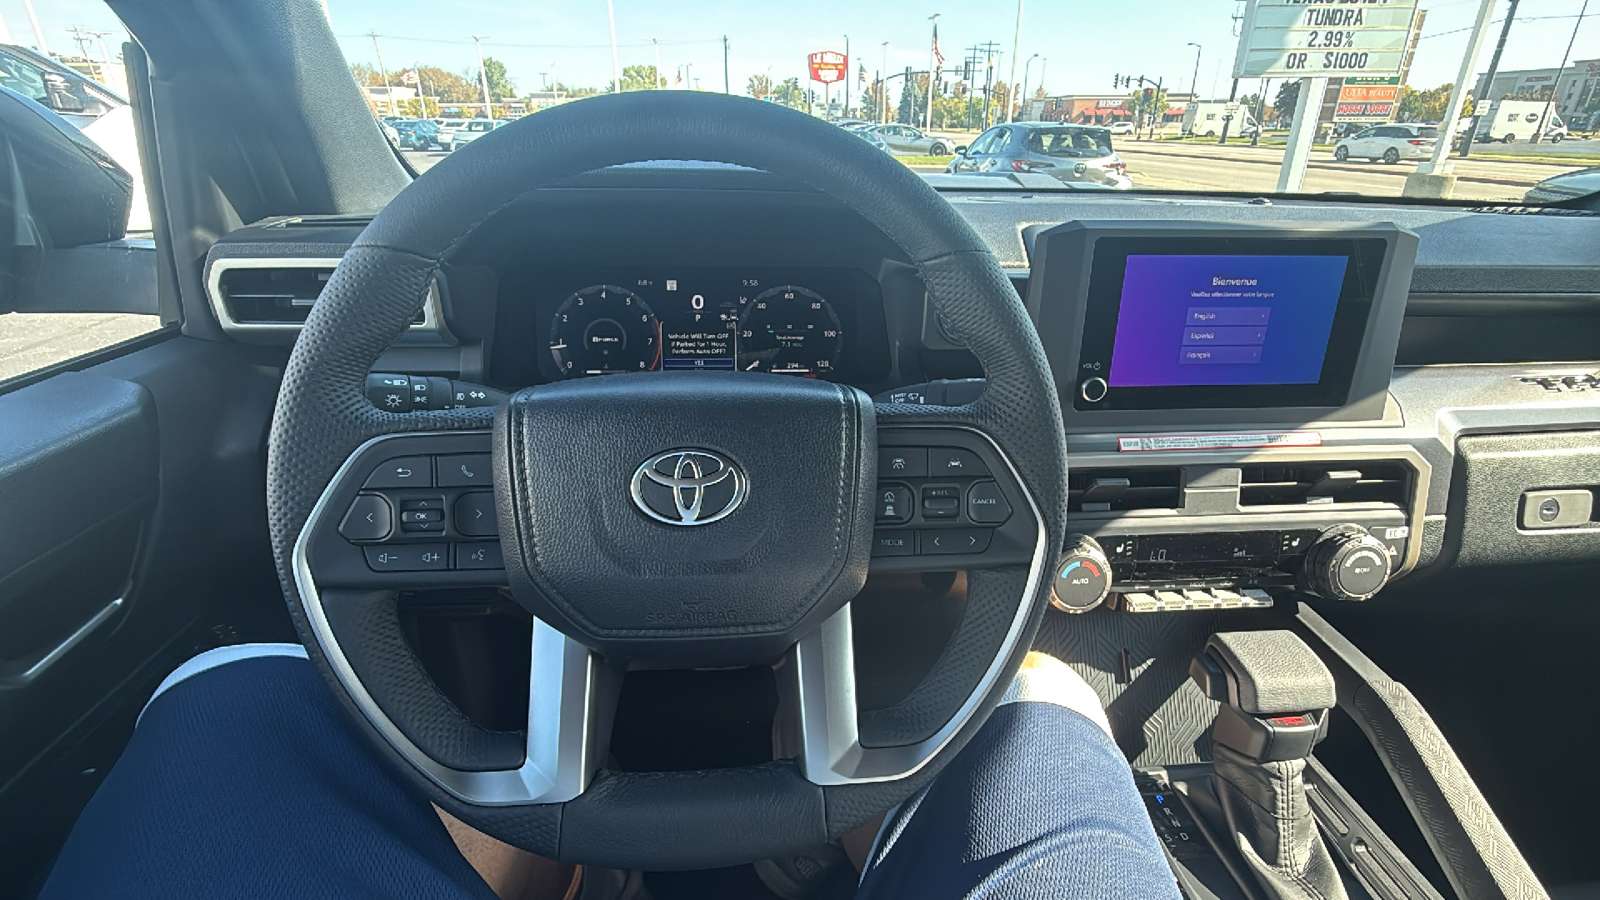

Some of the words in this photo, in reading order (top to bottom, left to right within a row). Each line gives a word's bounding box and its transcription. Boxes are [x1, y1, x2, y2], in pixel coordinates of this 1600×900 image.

[1306, 8, 1364, 27] TUNDRA
[1307, 30, 1355, 48] 2.99%
[1286, 52, 1308, 70] OR
[1343, 87, 1367, 98] ULTA
[1368, 89, 1395, 97] BEAUTY
[1337, 103, 1365, 115] HOBBY
[1365, 103, 1391, 115] LOBBY
[742, 279, 759, 287] 9:58
[1212, 276, 1258, 286] Bienvenue
[600, 291, 606, 299] 4
[784, 292, 794, 300] 60
[1256, 291, 1275, 299] langue
[578, 298, 584, 306] 3
[691, 294, 704, 310] 0
[562, 314, 568, 322] 2
[642, 314, 648, 322] 6
[695, 314, 701, 322] P
[1193, 312, 1216, 321] English
[742, 330, 752, 338] 20
[823, 330, 837, 338] 100
[1190, 332, 1214, 340] Español
[648, 338, 653, 346] 7
[1186, 351, 1211, 359] Français
[566, 361, 573, 369] 0
[639, 361, 645, 369] 8
[816, 360, 829, 368] 120
[1071, 577, 1089, 585] AUTO
[646, 612, 676, 623] SRS
[680, 609, 737, 623] AIRBAG
[1270, 716, 1307, 727] TRD
[1155, 794, 1164, 804] P
[1162, 807, 1174, 816] R
[1171, 819, 1181, 828] N
